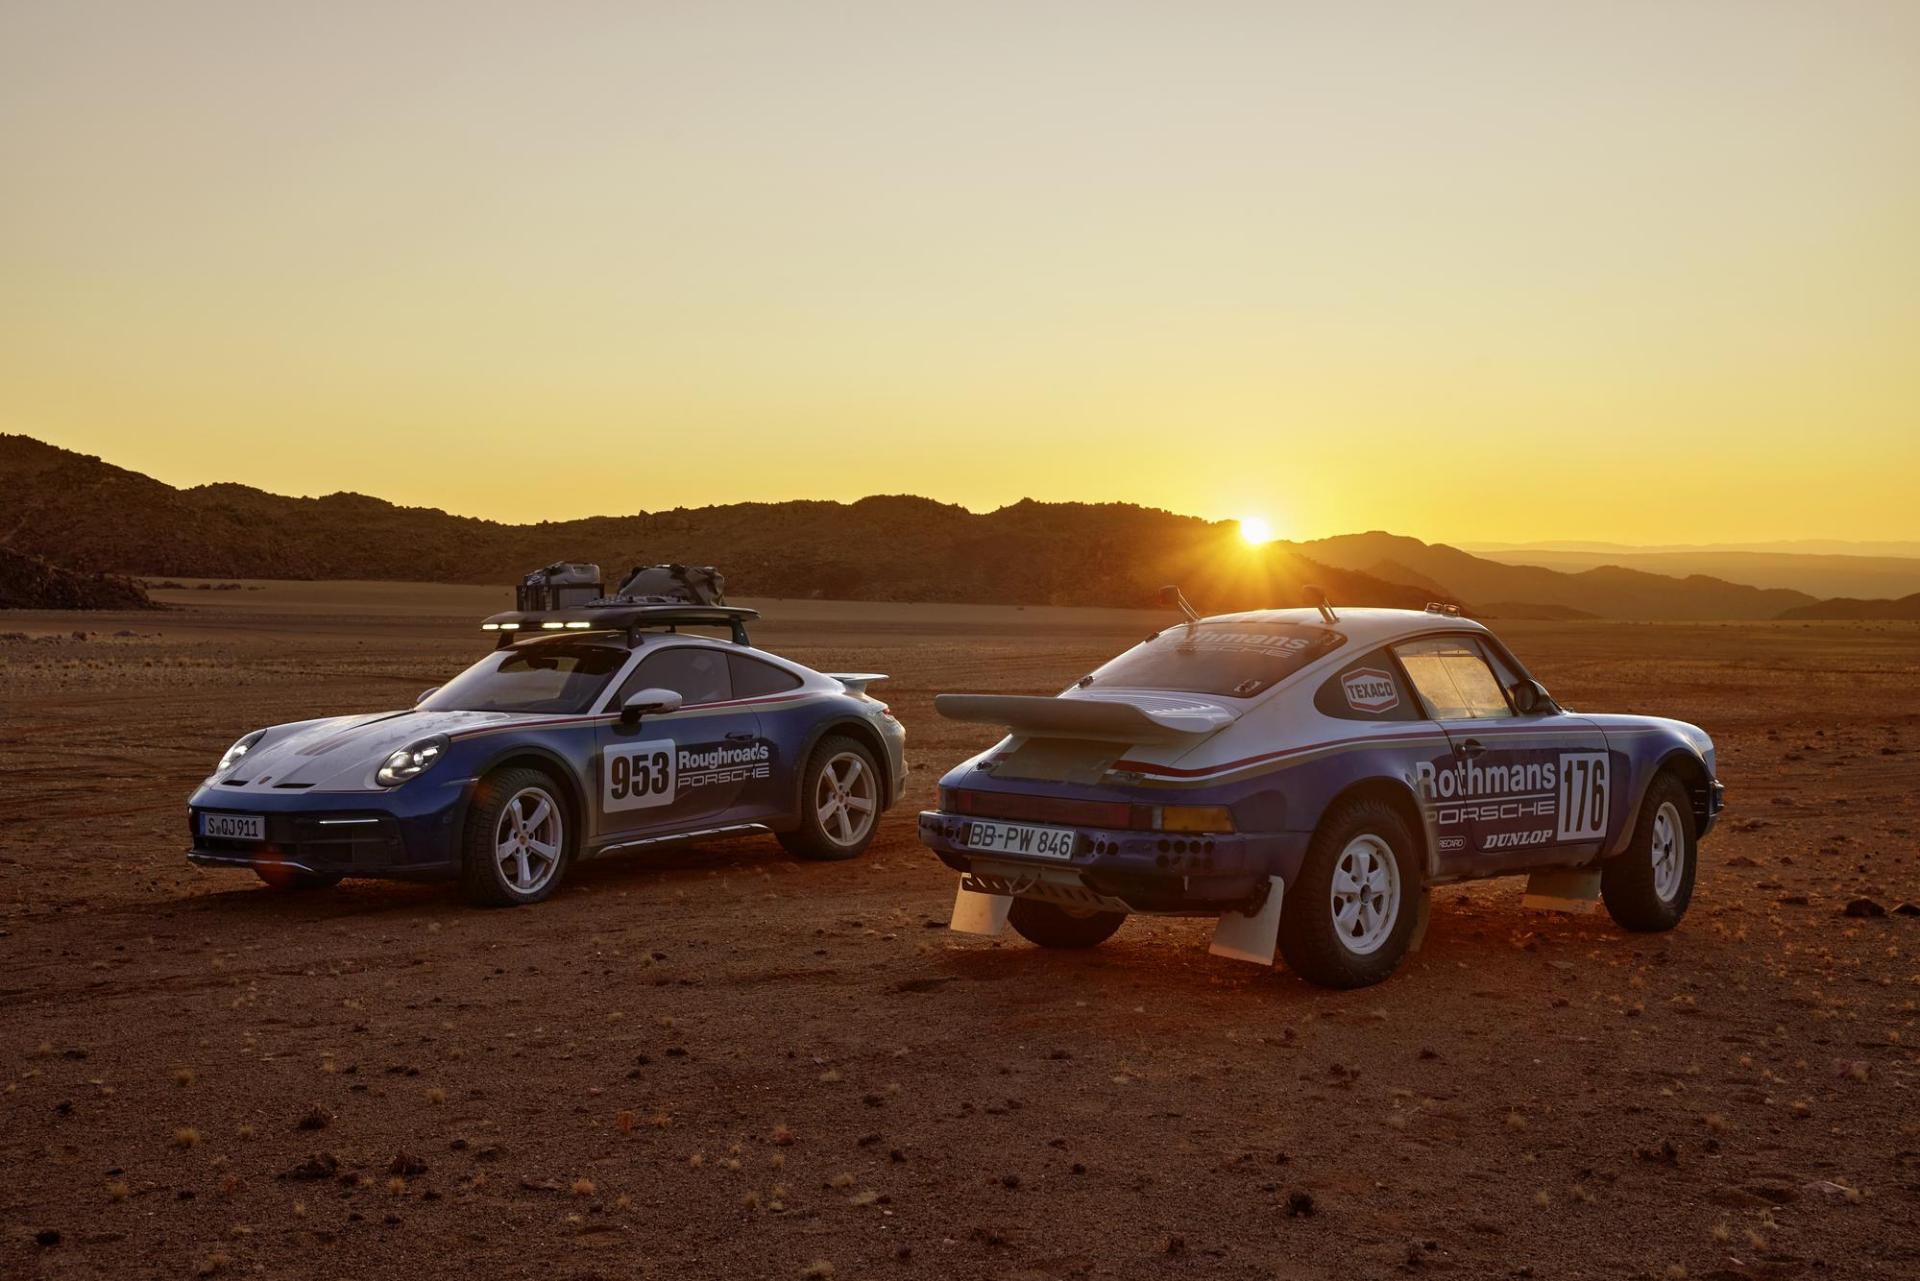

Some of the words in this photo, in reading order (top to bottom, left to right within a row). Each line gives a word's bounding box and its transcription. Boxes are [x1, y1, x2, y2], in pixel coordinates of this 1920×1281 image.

[1347, 681, 1393, 699] TEXACO
[678, 743, 769, 769] Roughroads
[611, 752, 670, 800] 953
[677, 767, 770, 788] PORSCHE
[1416, 758, 1556, 798] Rothmans
[1564, 759, 1605, 833] 176
[1424, 800, 1555, 825] PORSCHE
[1037, 831, 1071, 856] 846
[1482, 829, 1553, 849] DUNLOP
